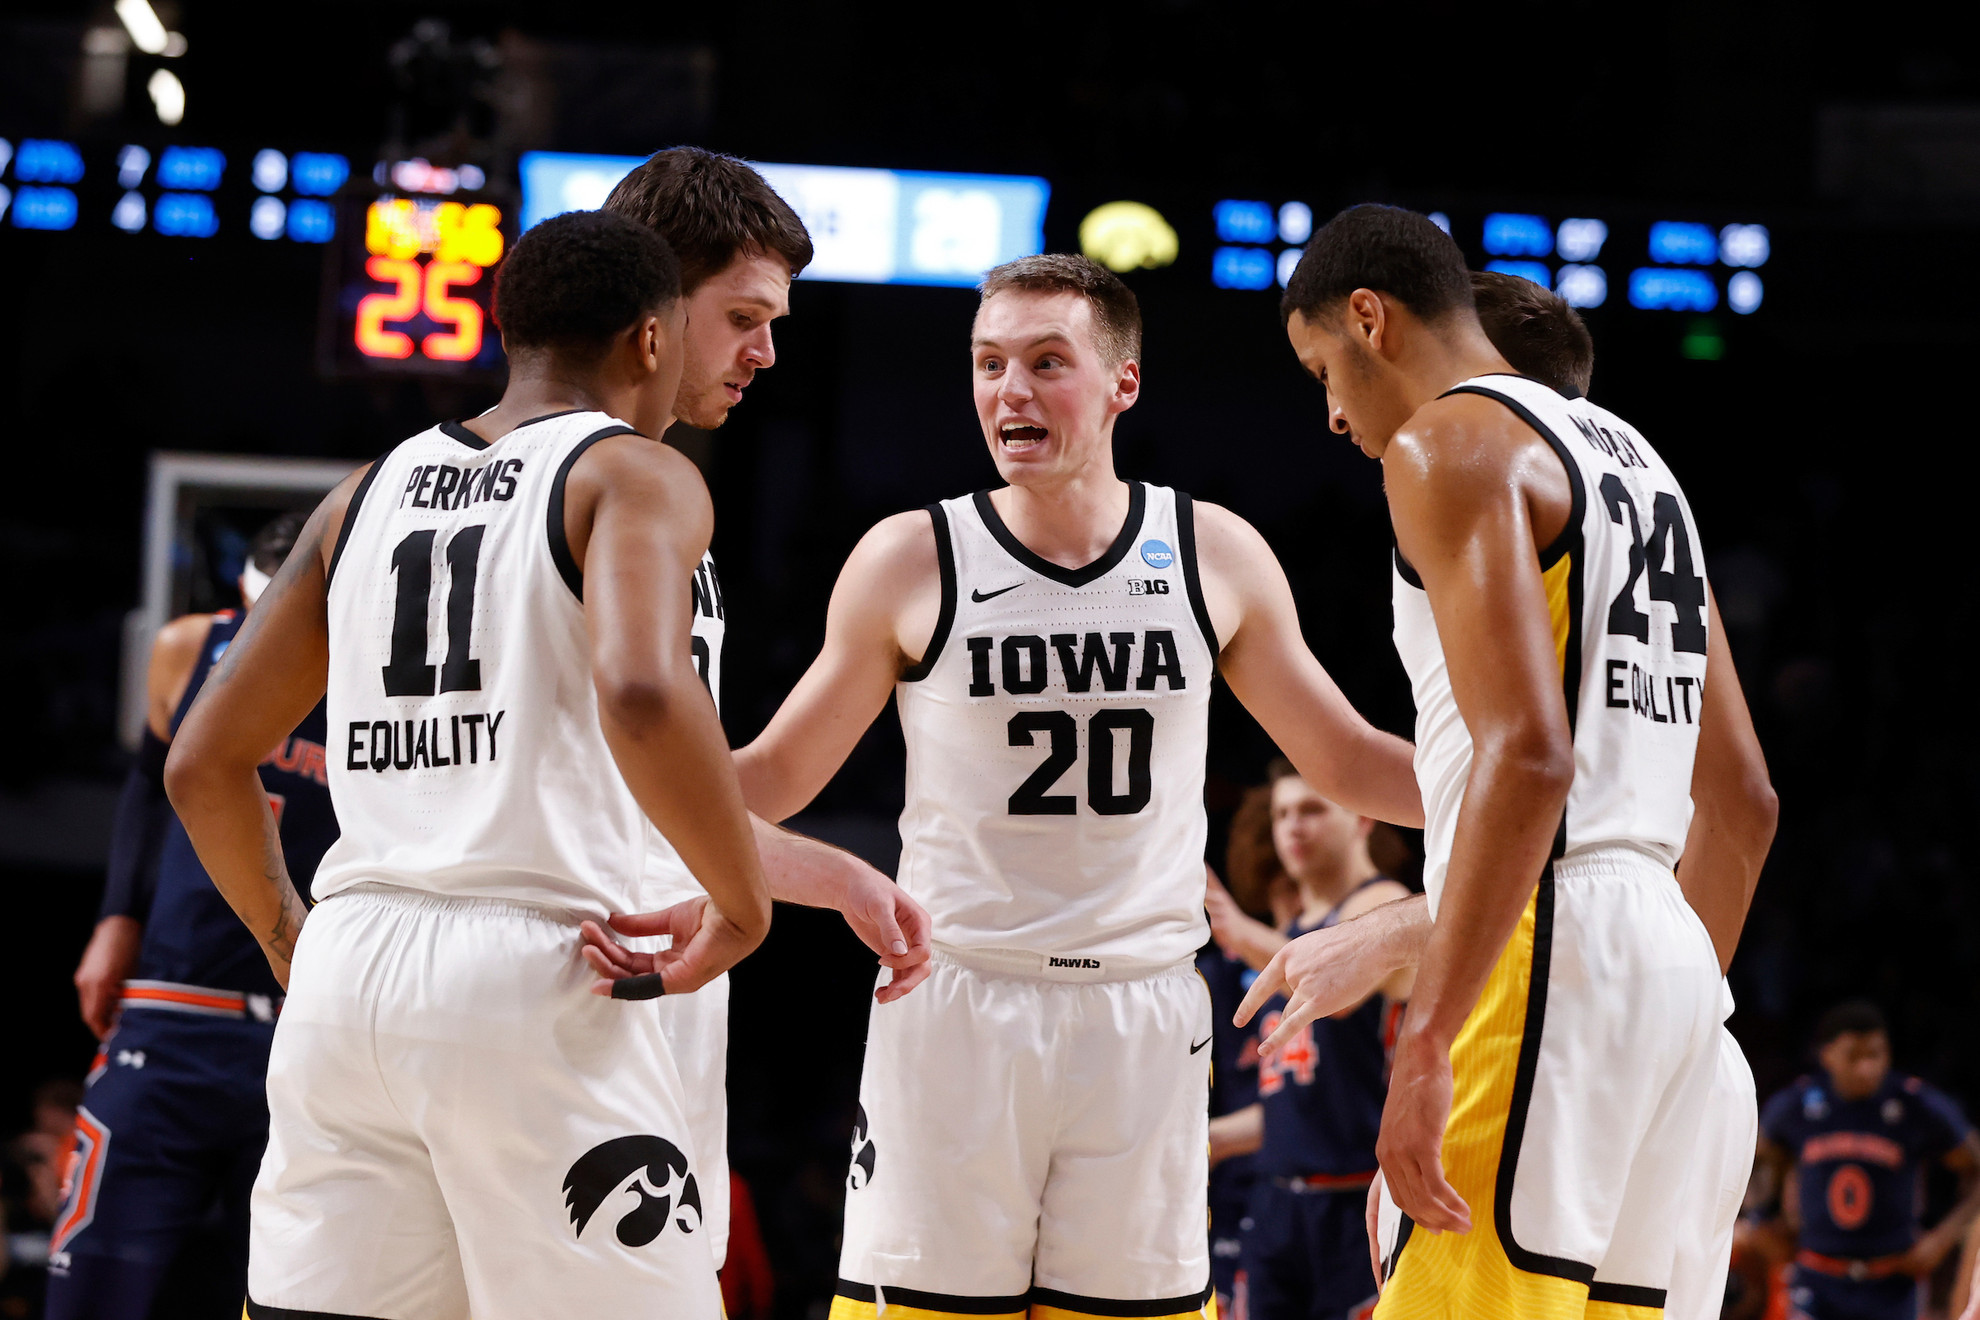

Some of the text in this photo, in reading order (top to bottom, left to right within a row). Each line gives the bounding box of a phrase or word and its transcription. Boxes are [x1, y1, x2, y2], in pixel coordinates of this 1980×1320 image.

[355, 255, 484, 361] 25
[400, 458, 524, 511] PERKINS
[1146, 552, 1173, 561] NCAA
[1600, 472, 1707, 656] 24
[382, 524, 487, 698] 11
[966, 630, 1187, 697] IOWA
[346, 710, 506, 773] EQUALITY
[1007, 708, 1155, 816] 20
[1048, 956, 1101, 969] HAWKS
[1827, 1165, 1873, 1231] 0
